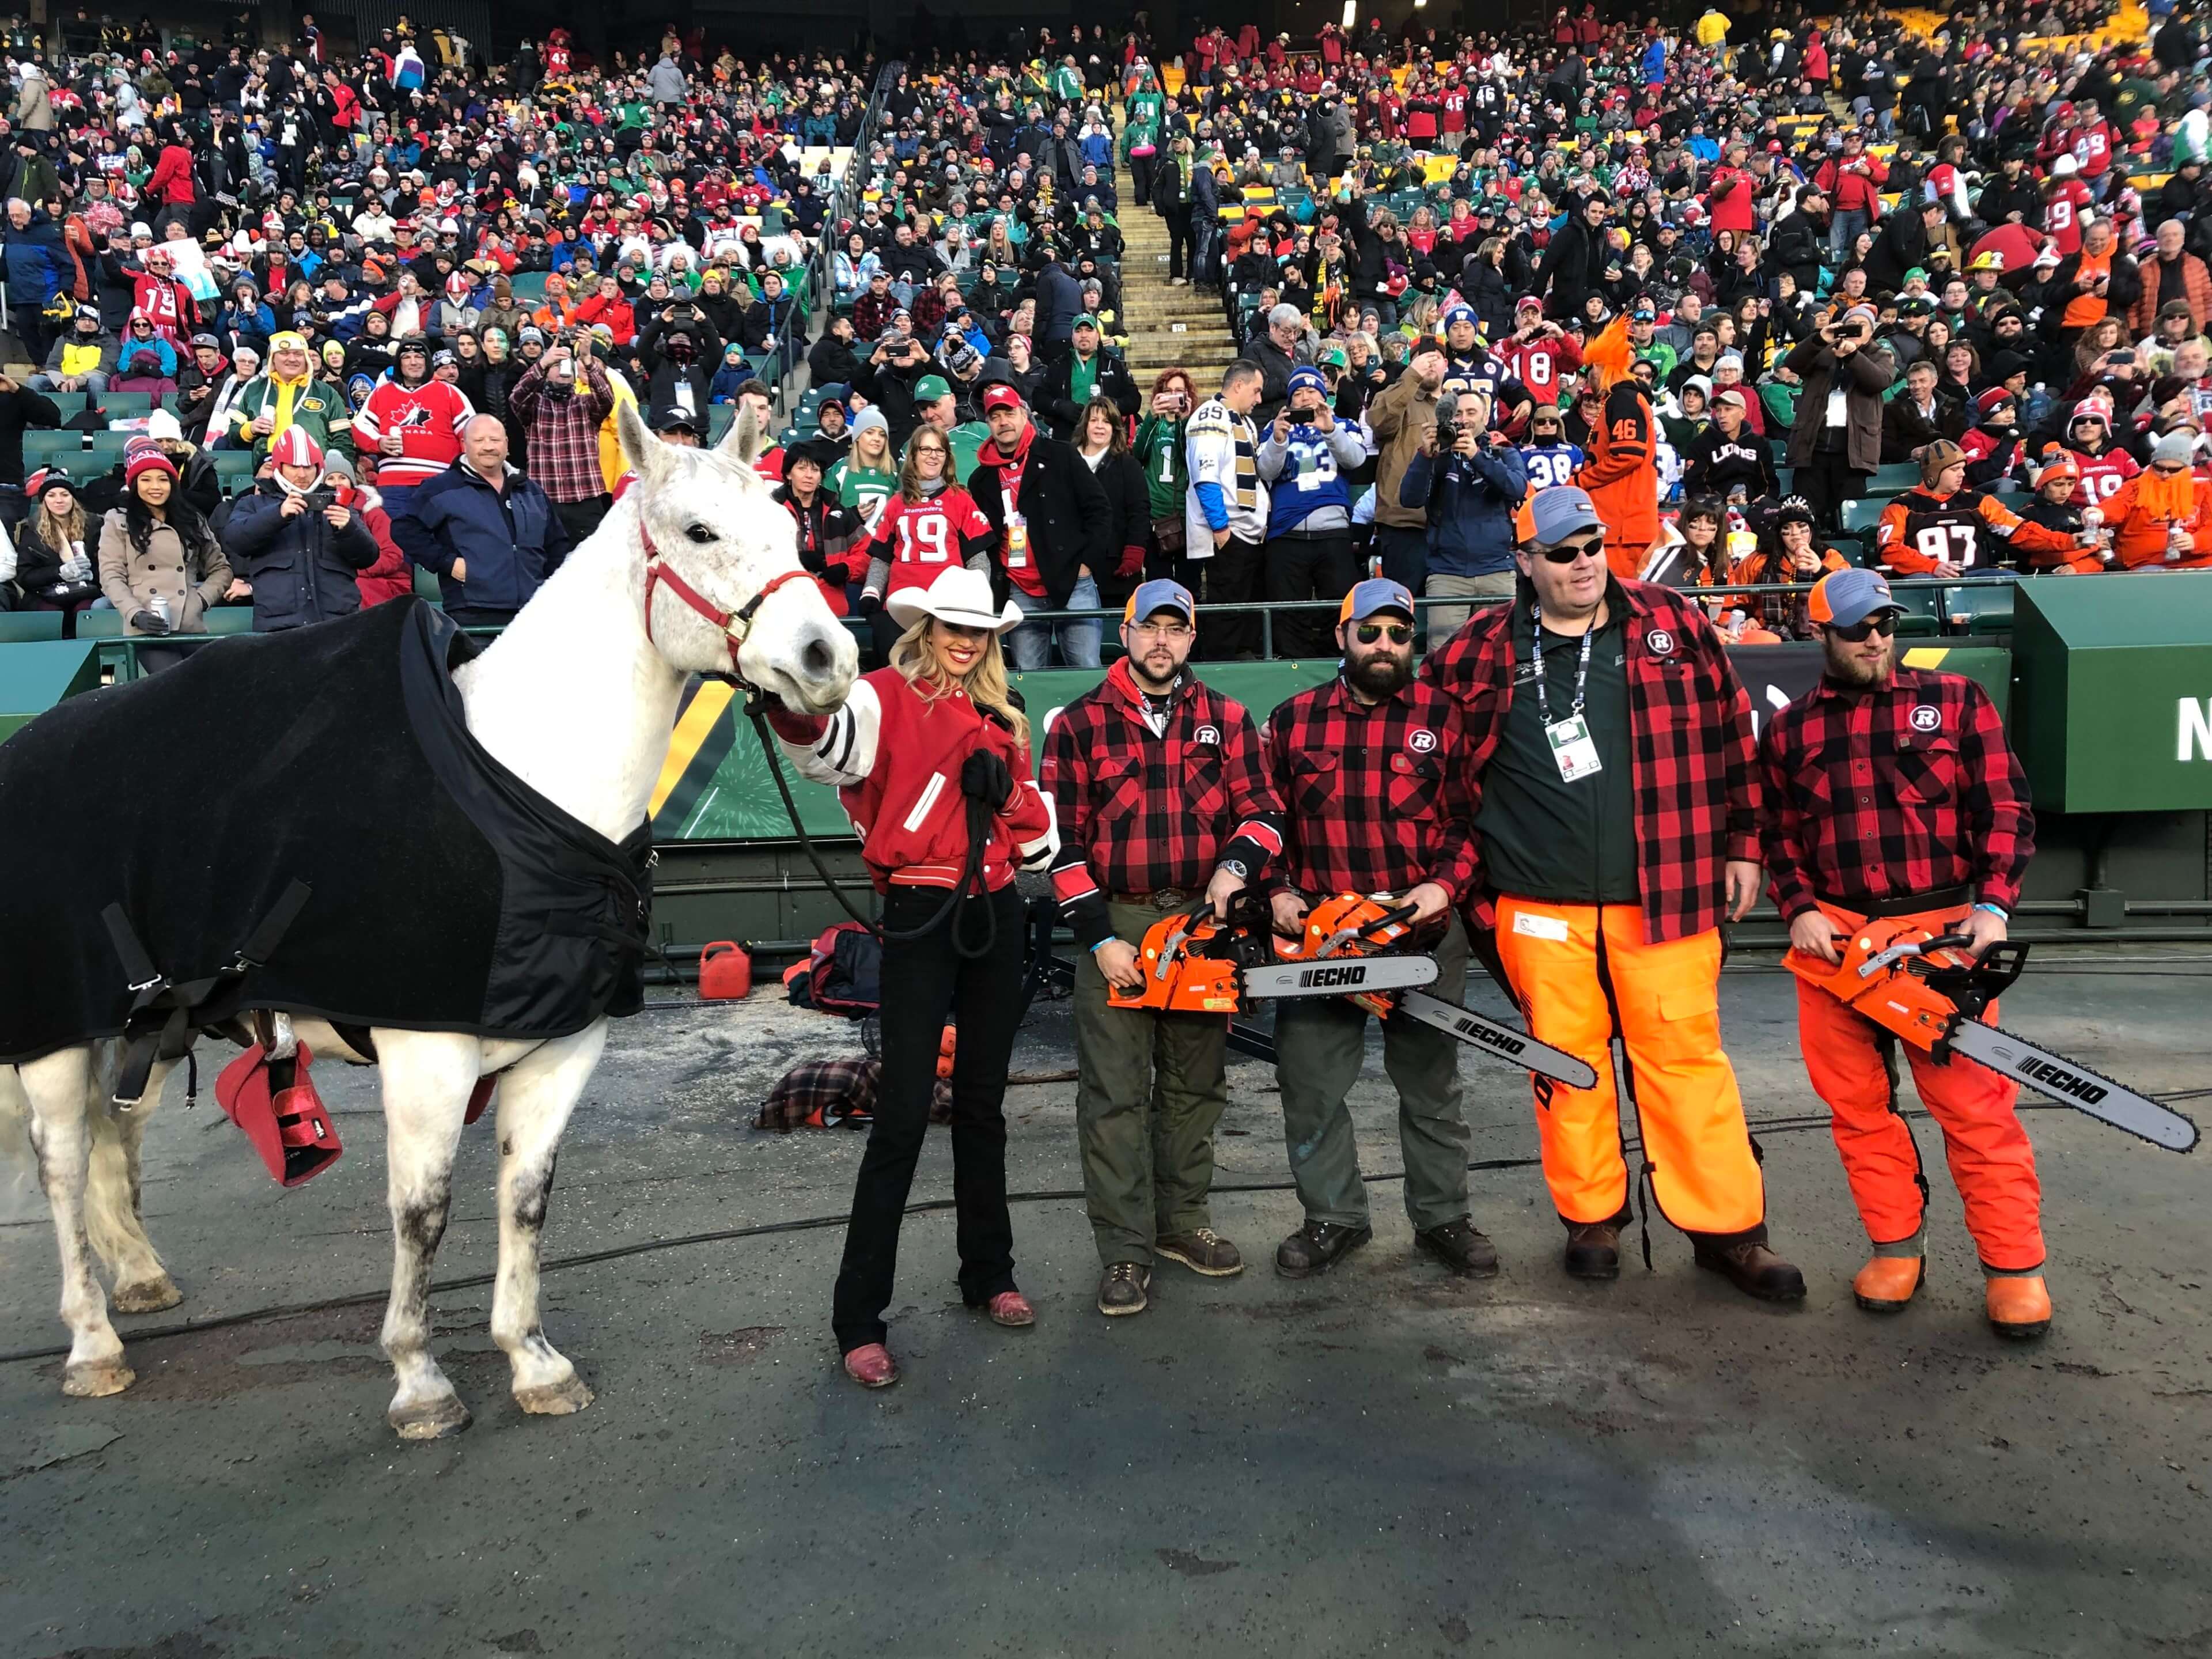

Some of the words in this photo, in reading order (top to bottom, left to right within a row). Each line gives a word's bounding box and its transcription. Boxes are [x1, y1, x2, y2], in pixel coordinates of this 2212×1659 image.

[1066, 71, 1077, 86] 8
[1445, 96, 1464, 111] 46
[1476, 87, 1495, 108] 46
[145, 289, 177, 317] 19
[1456, 311, 1468, 320] W
[1304, 377, 1316, 385] W
[1198, 407, 1223, 421] 85
[1612, 419, 1637, 440] 46
[1158, 446, 1173, 482] 1
[1528, 454, 1571, 489] 38
[897, 514, 948, 563] 19
[1916, 525, 1976, 566] 97
[1652, 634, 1669, 649] R
[1916, 710, 1934, 725] R
[1199, 730, 1215, 744] R
[2177, 697, 2212, 761] N
[1414, 734, 1431, 748] R
[1312, 966, 1366, 987] ECHO
[1467, 1023, 1525, 1055] ECHO
[2031, 1062, 2109, 1105] ECHO
